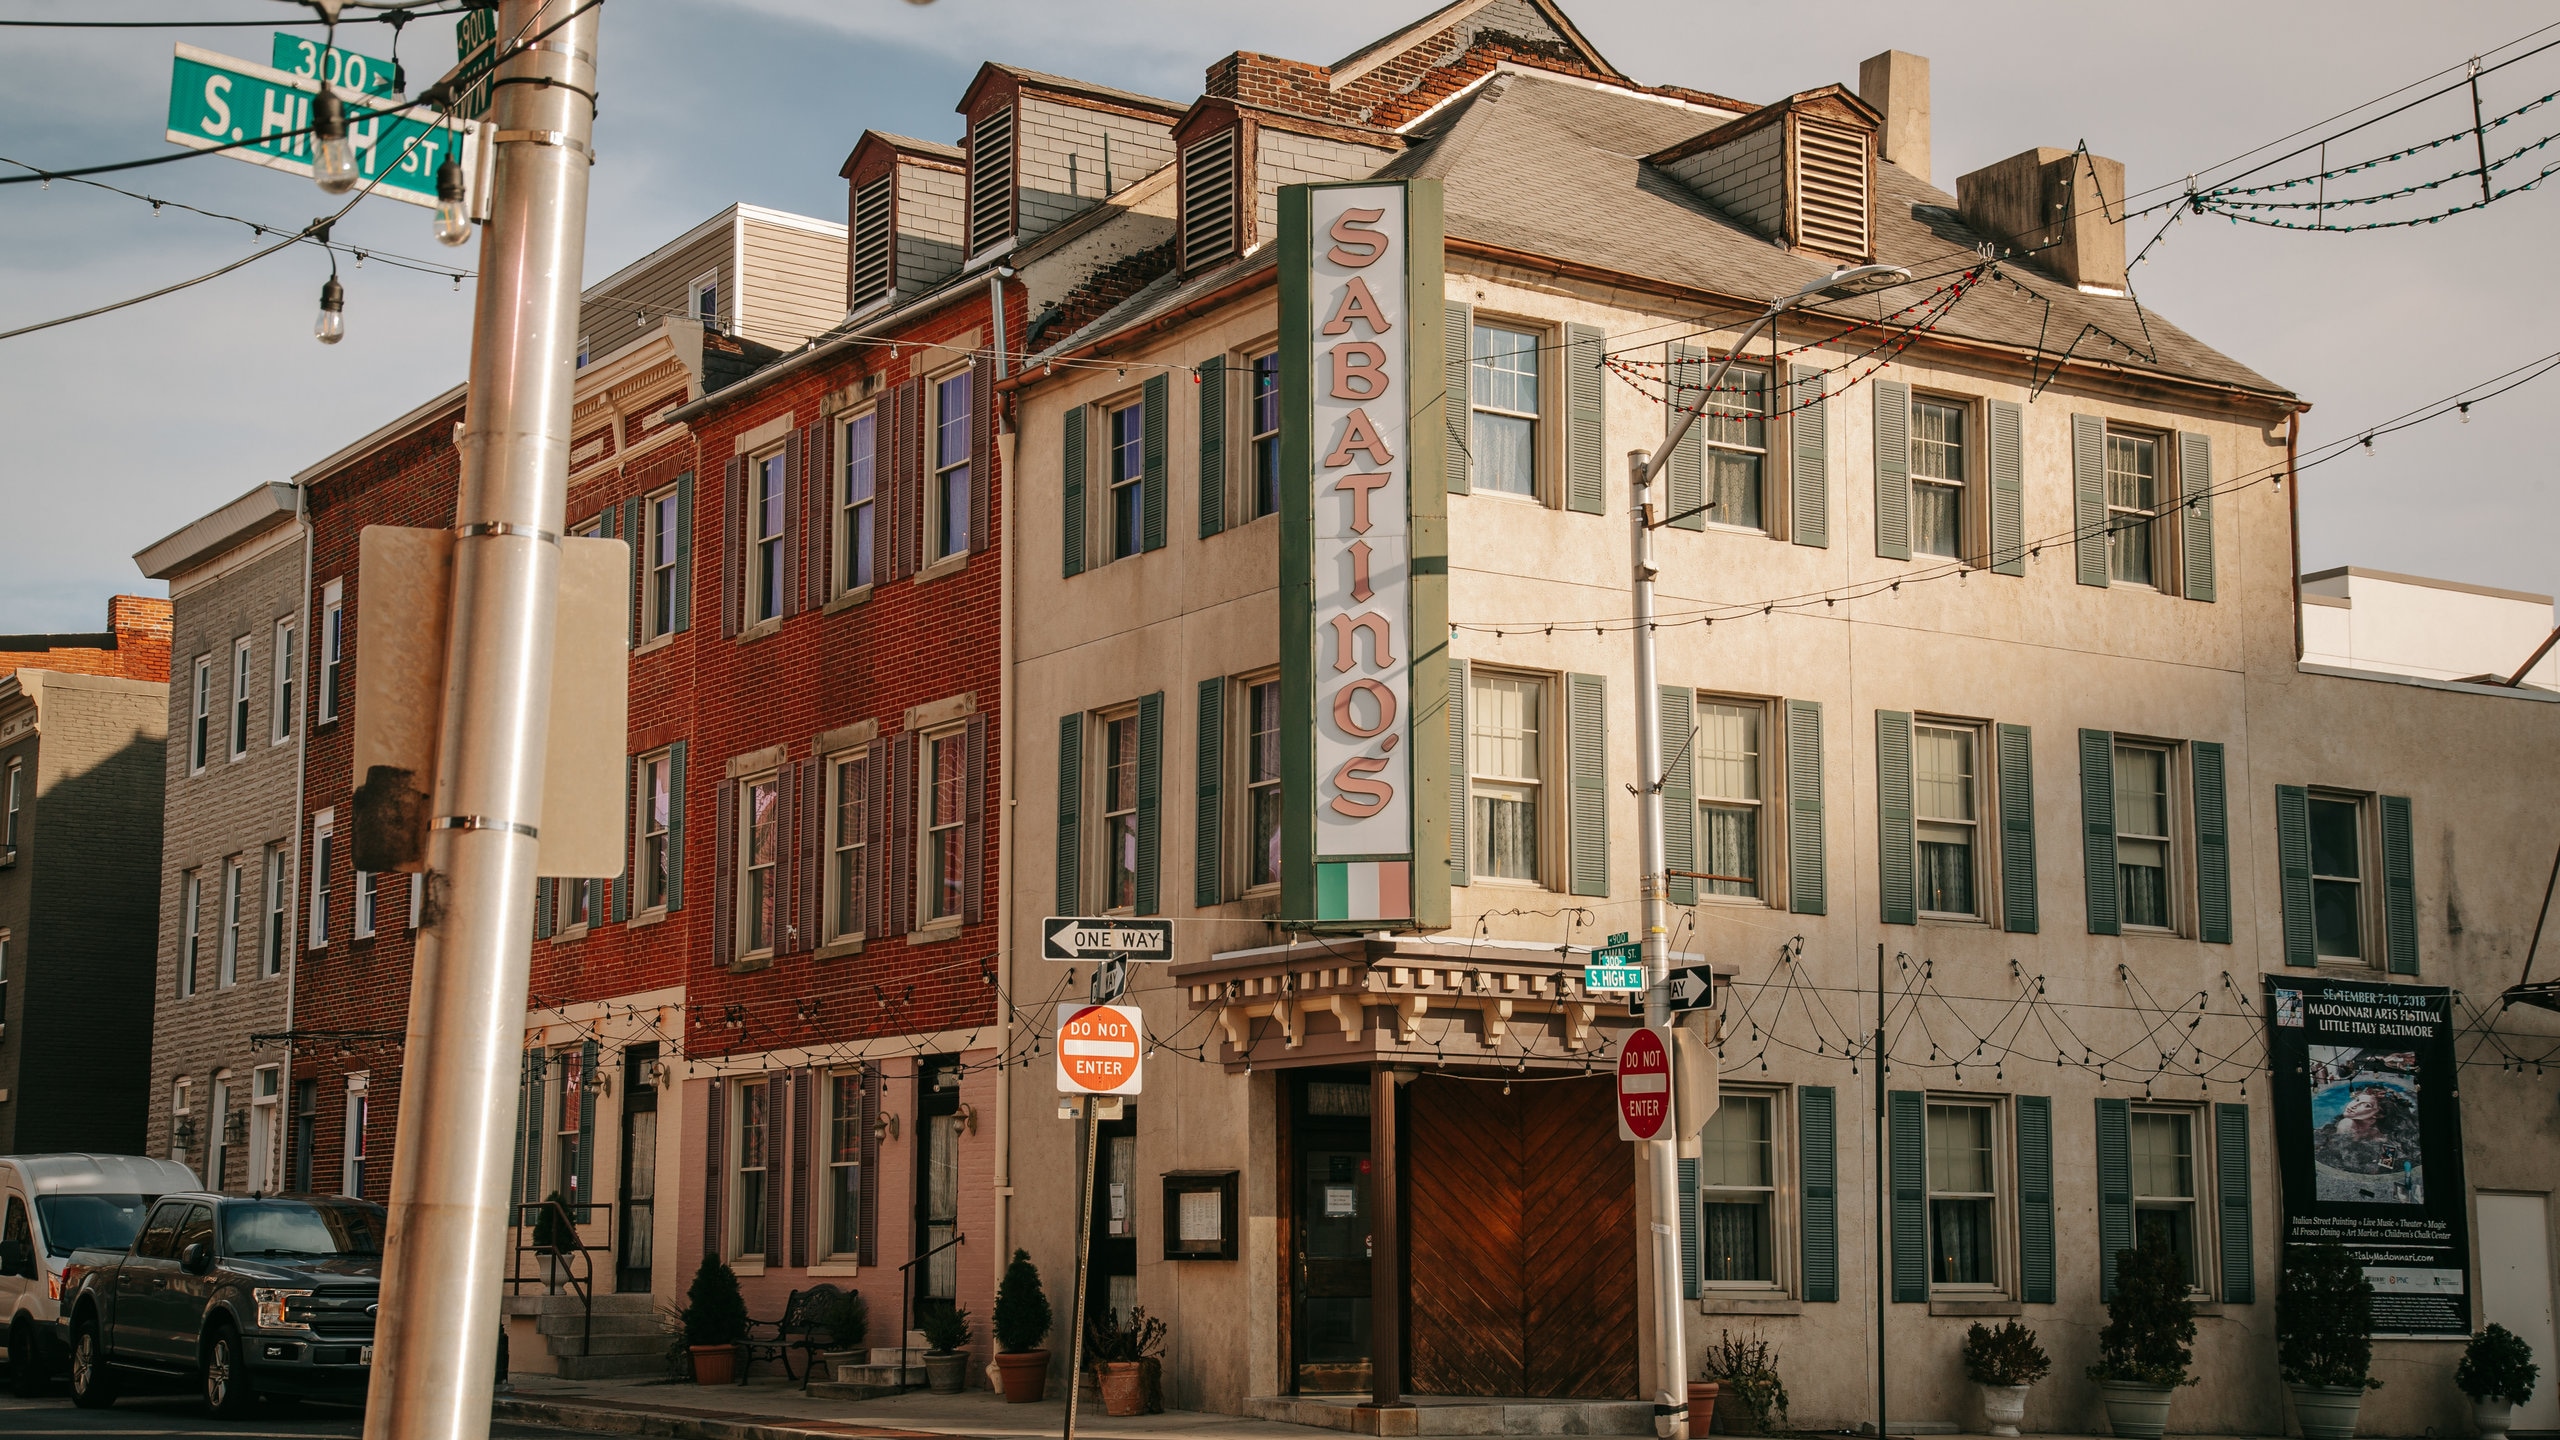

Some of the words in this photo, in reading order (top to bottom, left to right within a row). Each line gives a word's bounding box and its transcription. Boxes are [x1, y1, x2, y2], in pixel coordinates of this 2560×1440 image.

[462, 8, 486, 55] 900
[295, 41, 367, 94] 300
[201, 74, 243, 142] S.
[260, 88, 380, 175] HIH
[401, 136, 440, 177] ST
[1074, 931, 1112, 947] ONE
[1122, 932, 1160, 948] WAY
[1612, 933, 1626, 944] 900
[1605, 956, 1619, 966] 300
[1591, 970, 1601, 986] S.
[1602, 970, 1626, 987] HIGH
[1629, 974, 1638, 984] ST.
[1670, 980, 1686, 998] AY
[2308, 1003, 2372, 1019] MADONNARI
[2374, 1008, 2398, 1020] ARTS
[1070, 1022, 1091, 1036] DO
[1098, 1023, 1127, 1037] NOT
[2319, 1019, 2350, 1033] LITTLE
[2352, 1021, 2376, 1034] ITALY
[2379, 1023, 2433, 1038] BALTIMORE
[1076, 1060, 1123, 1075] ENTER
[1626, 1052, 1638, 1068] DO
[1643, 1050, 1661, 1067] NOT
[1629, 1100, 1659, 1117] ENTER
[2292, 1216, 2312, 1225] Italian
[2313, 1216, 2331, 1225] Street
[2332, 1217, 2357, 1227] Painting
[2377, 1218, 2394, 1227] Music
[2400, 1219, 2422, 1228] Theater
[2428, 1220, 2446, 1230] Magic
[2300, 1227, 2319, 1236] Fresco
[2320, 1227, 2341, 1238] Dining
[2346, 1228, 2357, 1236] Art
[2357, 1228, 2379, 1237] Market
[2384, 1229, 2413, 1239] Children's
[2414, 1230, 2431, 1239] Chalk
